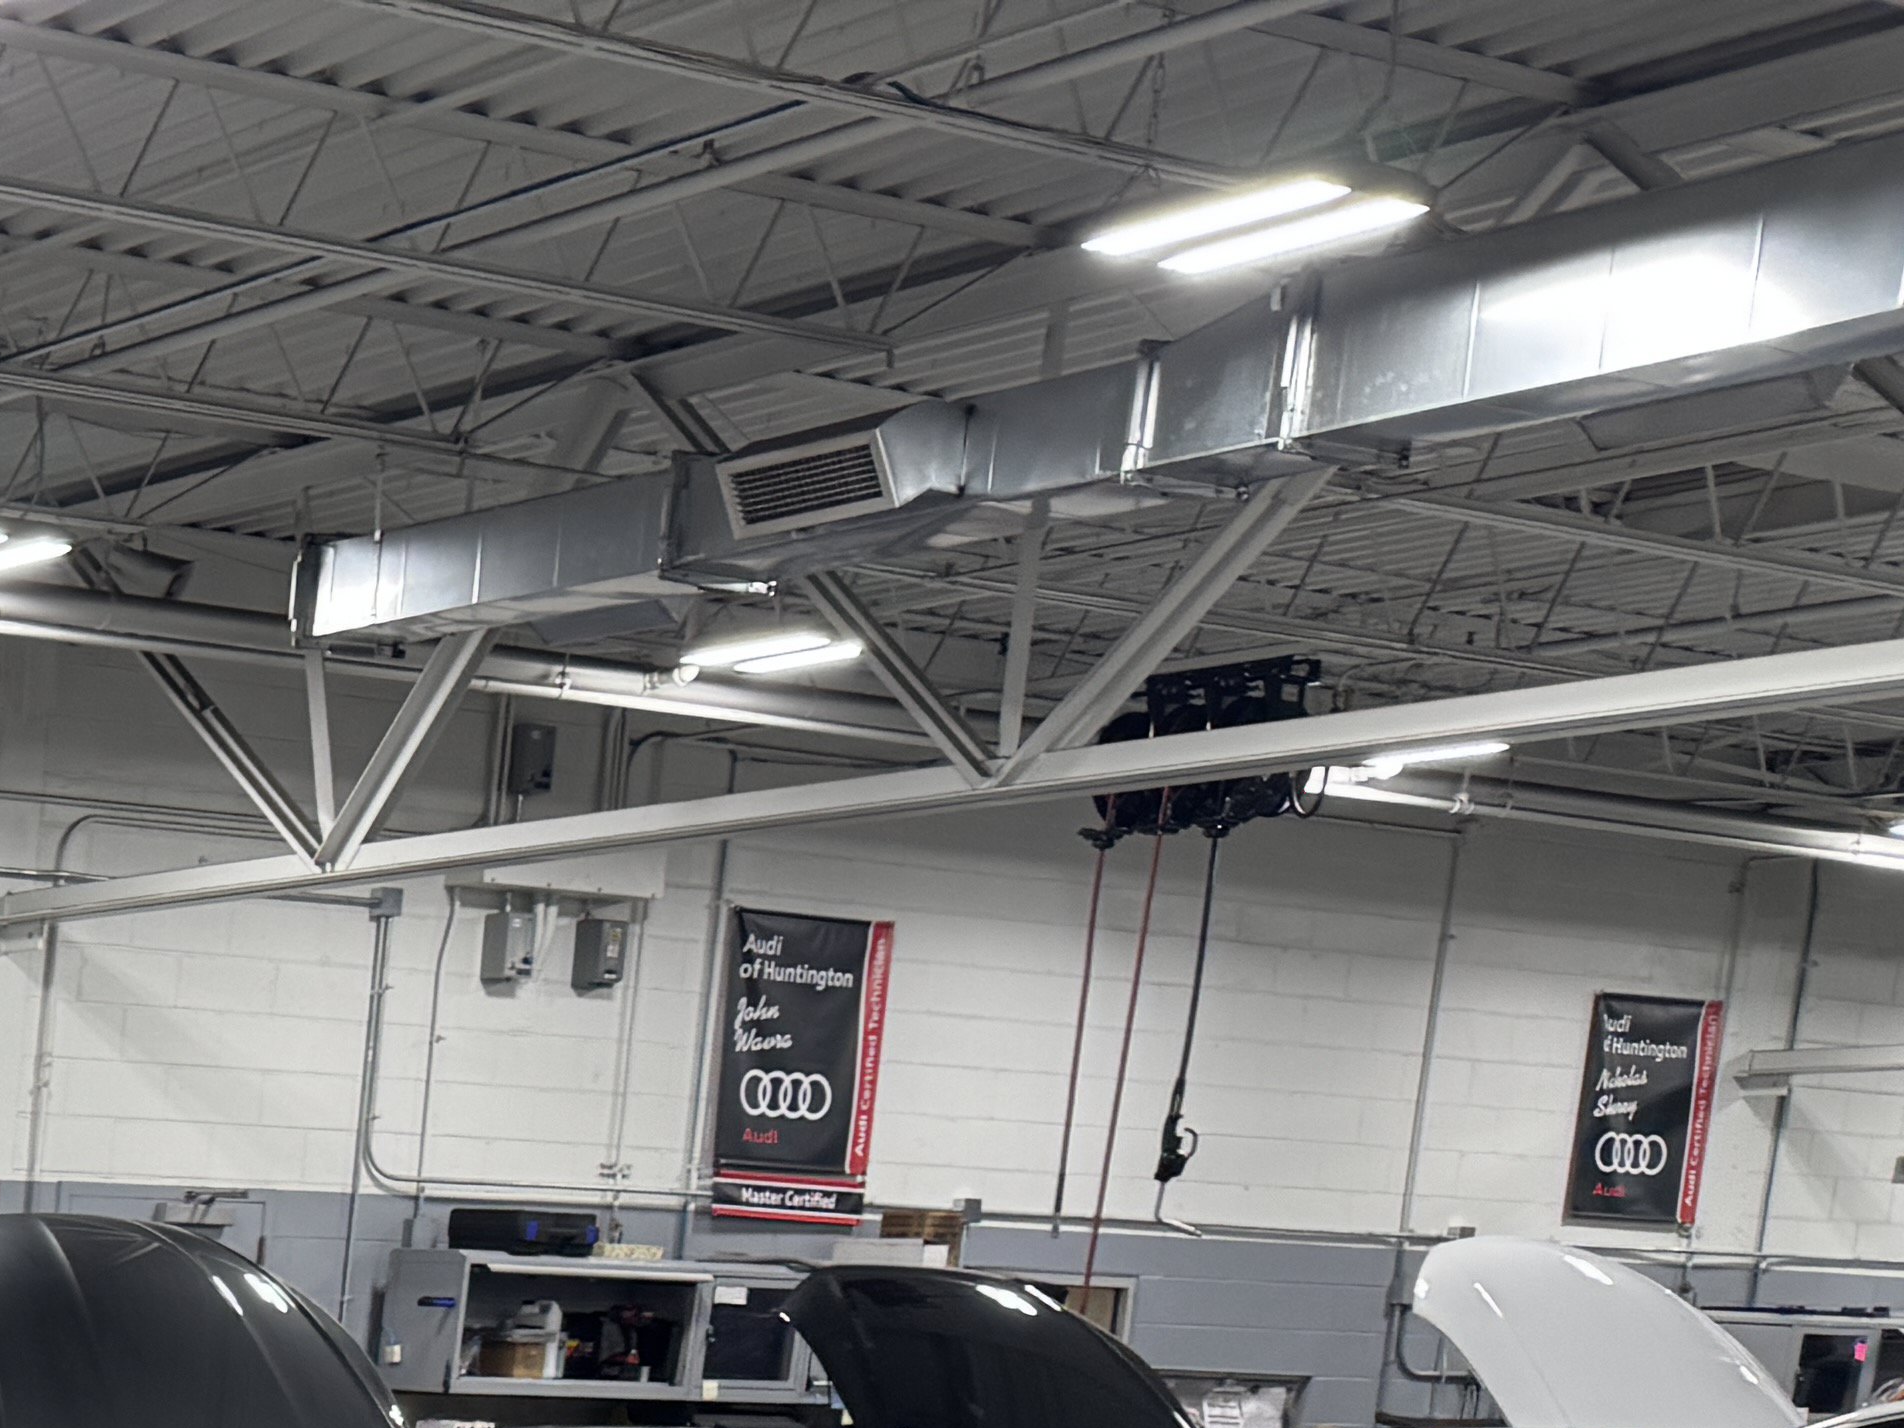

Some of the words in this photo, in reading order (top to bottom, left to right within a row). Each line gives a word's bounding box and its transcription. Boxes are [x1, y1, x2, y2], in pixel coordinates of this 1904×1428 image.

[743, 933, 784, 956] Audi
[739, 958, 762, 979] of
[763, 961, 854, 991] Huntington
[1612, 1038, 1688, 1062] Huntington
[741, 1187, 784, 1205] Master
[784, 1190, 837, 1209] Certified
